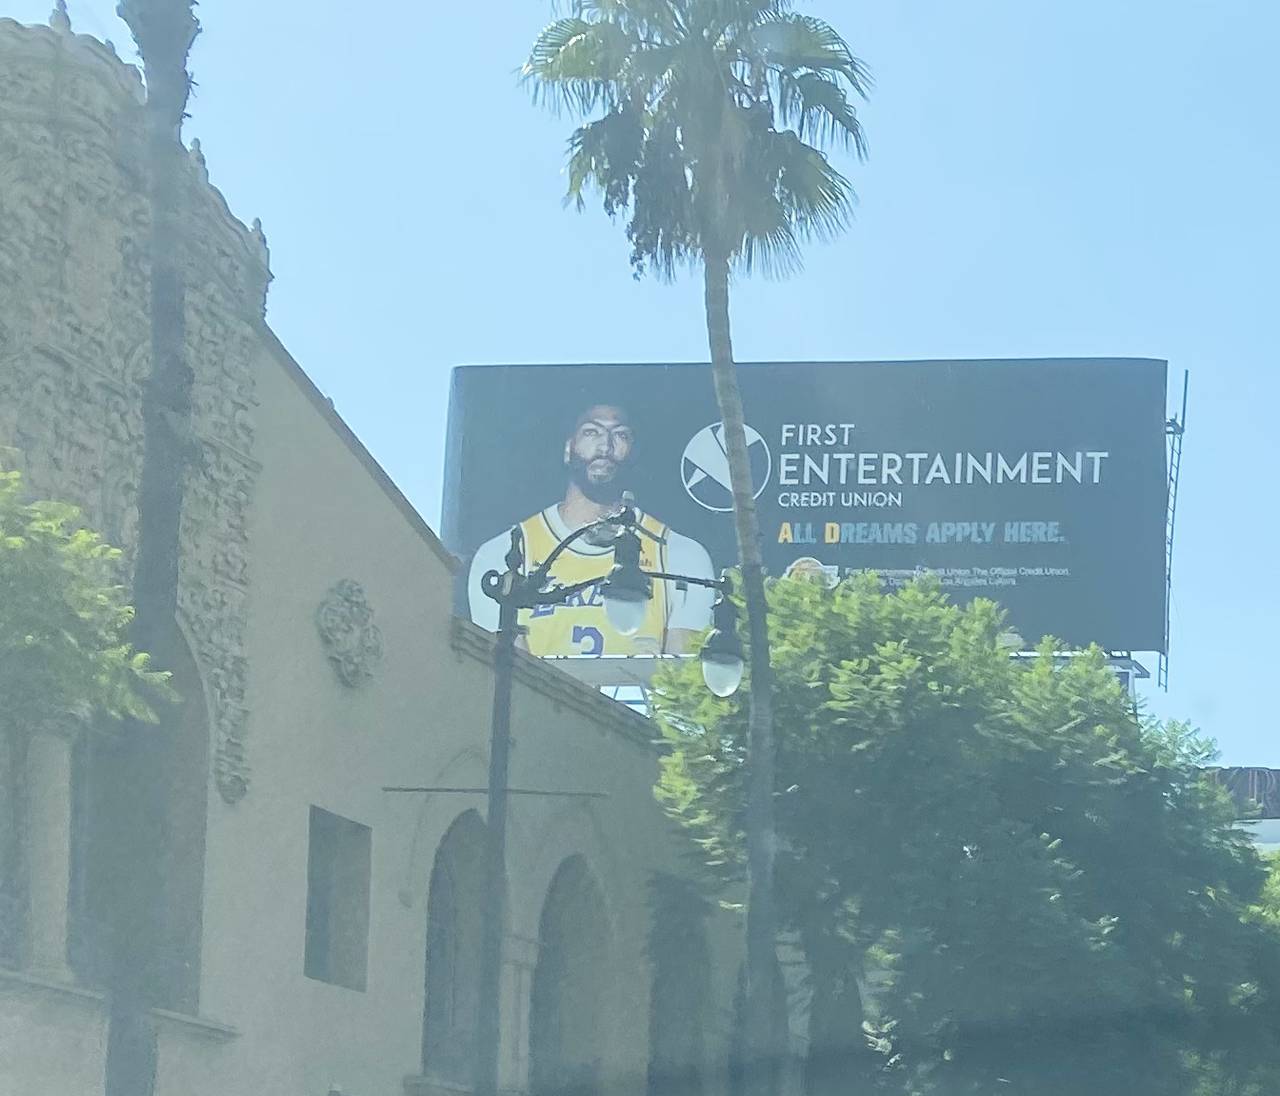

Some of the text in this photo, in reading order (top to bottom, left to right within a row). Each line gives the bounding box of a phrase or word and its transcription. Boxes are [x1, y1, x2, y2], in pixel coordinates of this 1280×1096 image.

[781, 423, 856, 446] FIRST
[779, 451, 1110, 485] ENTERTAINMENT
[778, 491, 903, 508] CREDIT UNION
[777, 522, 817, 544] ALL
[824, 521, 918, 545] DREAMS
[925, 521, 997, 545] APPLY
